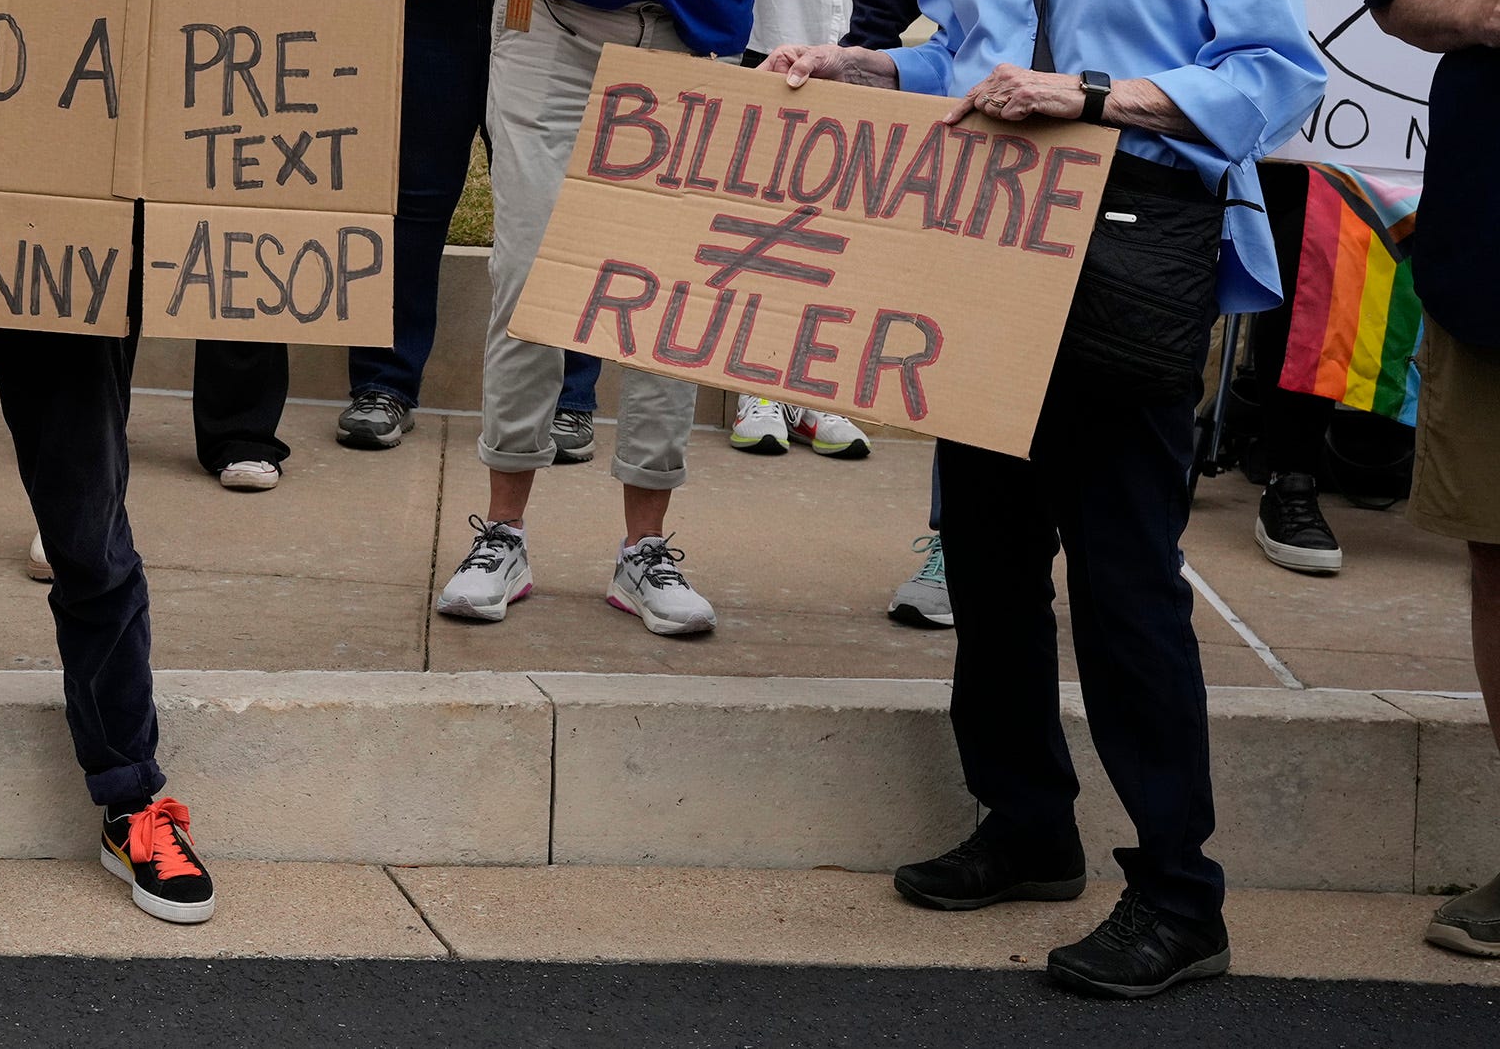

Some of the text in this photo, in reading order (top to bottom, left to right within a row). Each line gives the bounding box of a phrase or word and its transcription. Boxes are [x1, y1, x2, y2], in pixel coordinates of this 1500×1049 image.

[58, 17, 119, 119] A
[184, 126, 358, 192] TEXT
[588, 83, 1102, 258] BILLIONAIRE
[573, 259, 945, 422] RULER
